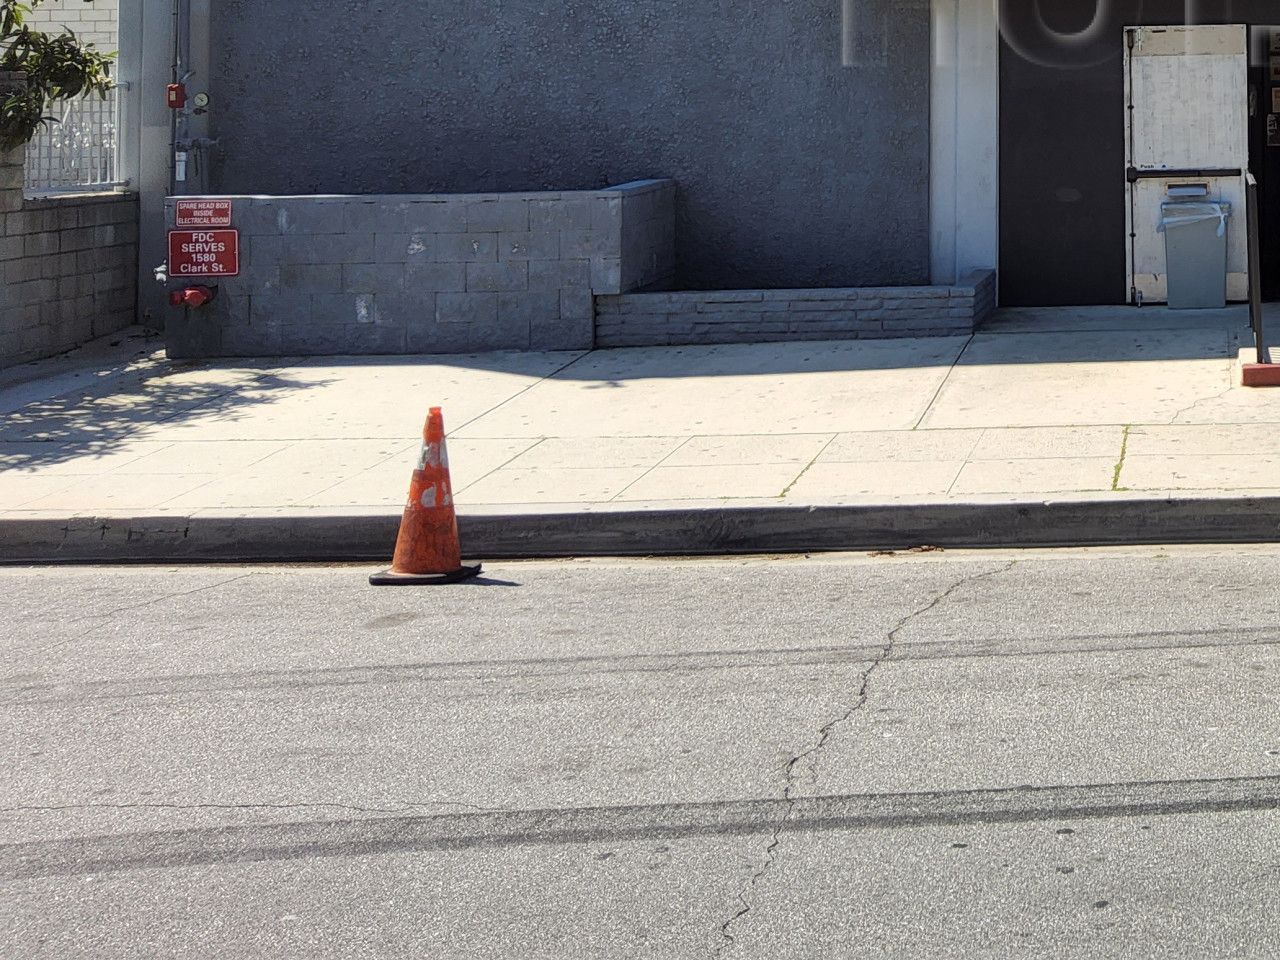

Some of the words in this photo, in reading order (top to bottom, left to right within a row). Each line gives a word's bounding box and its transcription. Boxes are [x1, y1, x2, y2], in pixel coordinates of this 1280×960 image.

[192, 233, 215, 242] FDC
[181, 243, 225, 252] SERVES
[191, 253, 216, 262] 1580
[180, 263, 208, 272] Clark
[211, 262, 226, 272] St.
